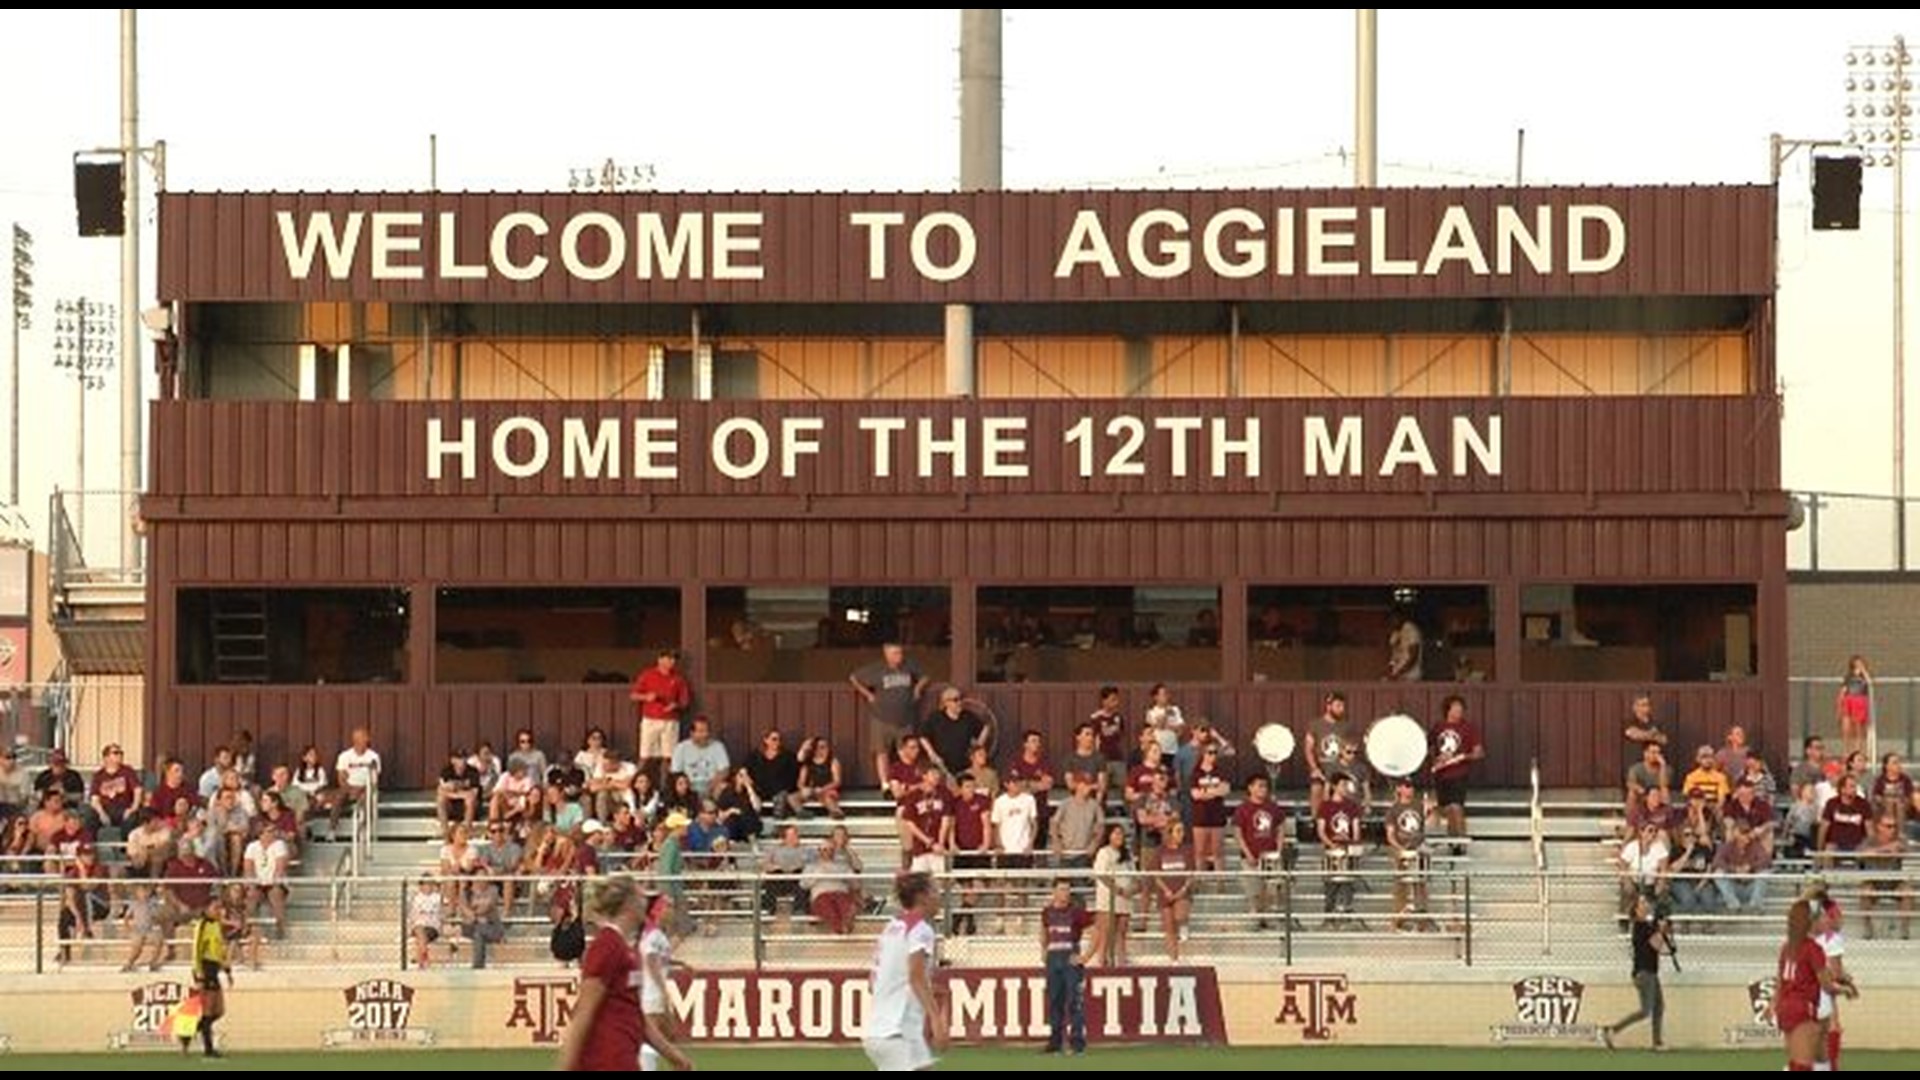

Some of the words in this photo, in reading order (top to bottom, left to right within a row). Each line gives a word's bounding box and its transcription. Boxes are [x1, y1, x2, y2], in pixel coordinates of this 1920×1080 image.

[277, 211, 764, 280] WELCOME
[850, 211, 977, 281] TO
[1055, 204, 1627, 279] AGGIELAND
[427, 416, 678, 479] HOME
[711, 417, 824, 479] OF
[859, 416, 1029, 478] THE
[1064, 415, 1260, 477] 12TH
[1304, 415, 1502, 476] MAN
[355, 979, 404, 1001] NCAA
[1523, 976, 1574, 997] SEC
[133, 1003, 170, 1032] 20
[348, 1001, 411, 1030] 2017
[664, 977, 873, 1038] MAROO
[947, 975, 1203, 1038] MILTIA
[1517, 996, 1579, 1025] 2017
